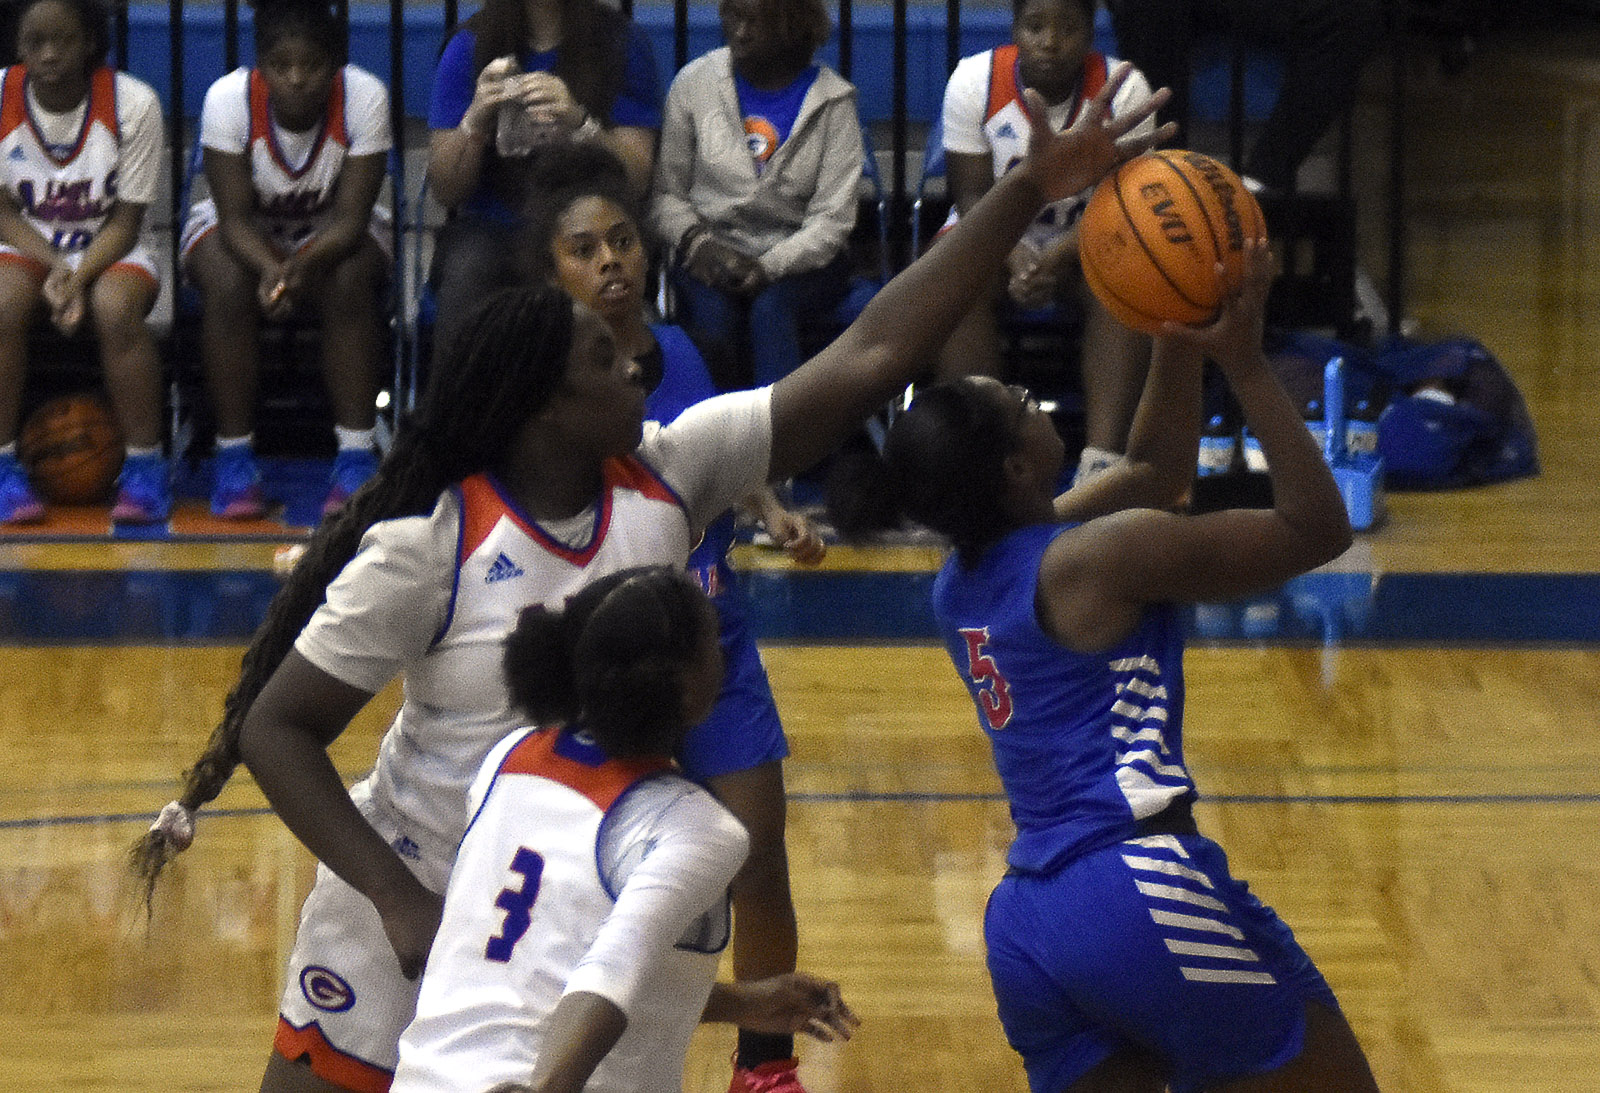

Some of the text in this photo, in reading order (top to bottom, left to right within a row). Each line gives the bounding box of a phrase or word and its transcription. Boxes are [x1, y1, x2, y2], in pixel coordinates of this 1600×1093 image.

[1140, 181, 1193, 244] EVO
[957, 625, 1013, 731] 5
[484, 845, 546, 964] 3
